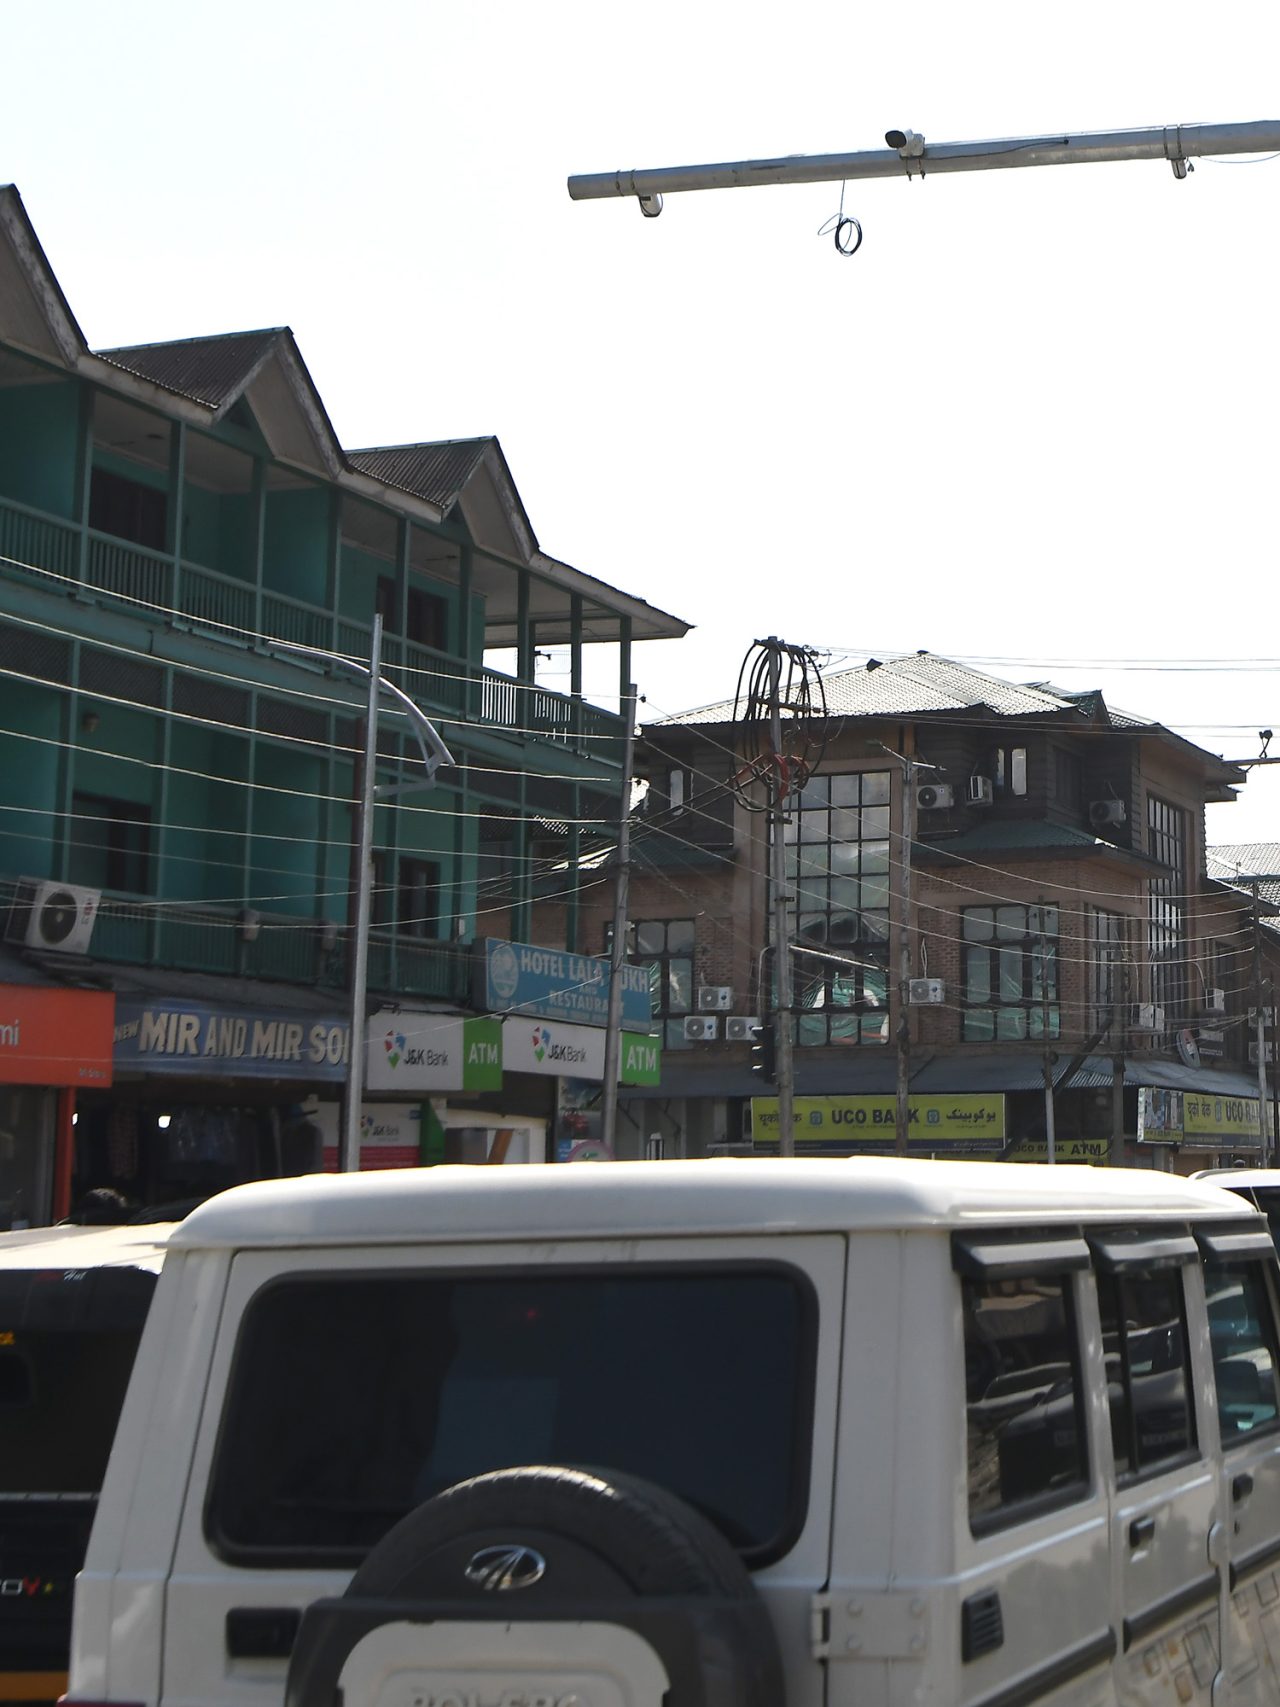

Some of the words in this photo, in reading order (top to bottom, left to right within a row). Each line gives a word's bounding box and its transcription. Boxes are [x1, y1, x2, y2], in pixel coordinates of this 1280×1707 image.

[520, 951, 566, 979] HOTEL
[549, 991, 625, 1017] RESTAURAT
[139, 1011, 200, 1055] MIR
[204, 1017, 247, 1058] AND
[252, 1021, 303, 1061] MIR
[309, 1024, 350, 1065] SO
[403, 1048, 426, 1066] J&K
[426, 1050, 449, 1067] Bank
[468, 1042, 499, 1065] ATM
[547, 1044, 568, 1061] J&K
[567, 1046, 588, 1063] Bank
[625, 1046, 657, 1072] ATM
[831, 1109, 867, 1125] UCO
[872, 1109, 920, 1124] BAK
[1225, 1100, 1243, 1123] UCO
[1070, 1143, 1102, 1155] ATM
